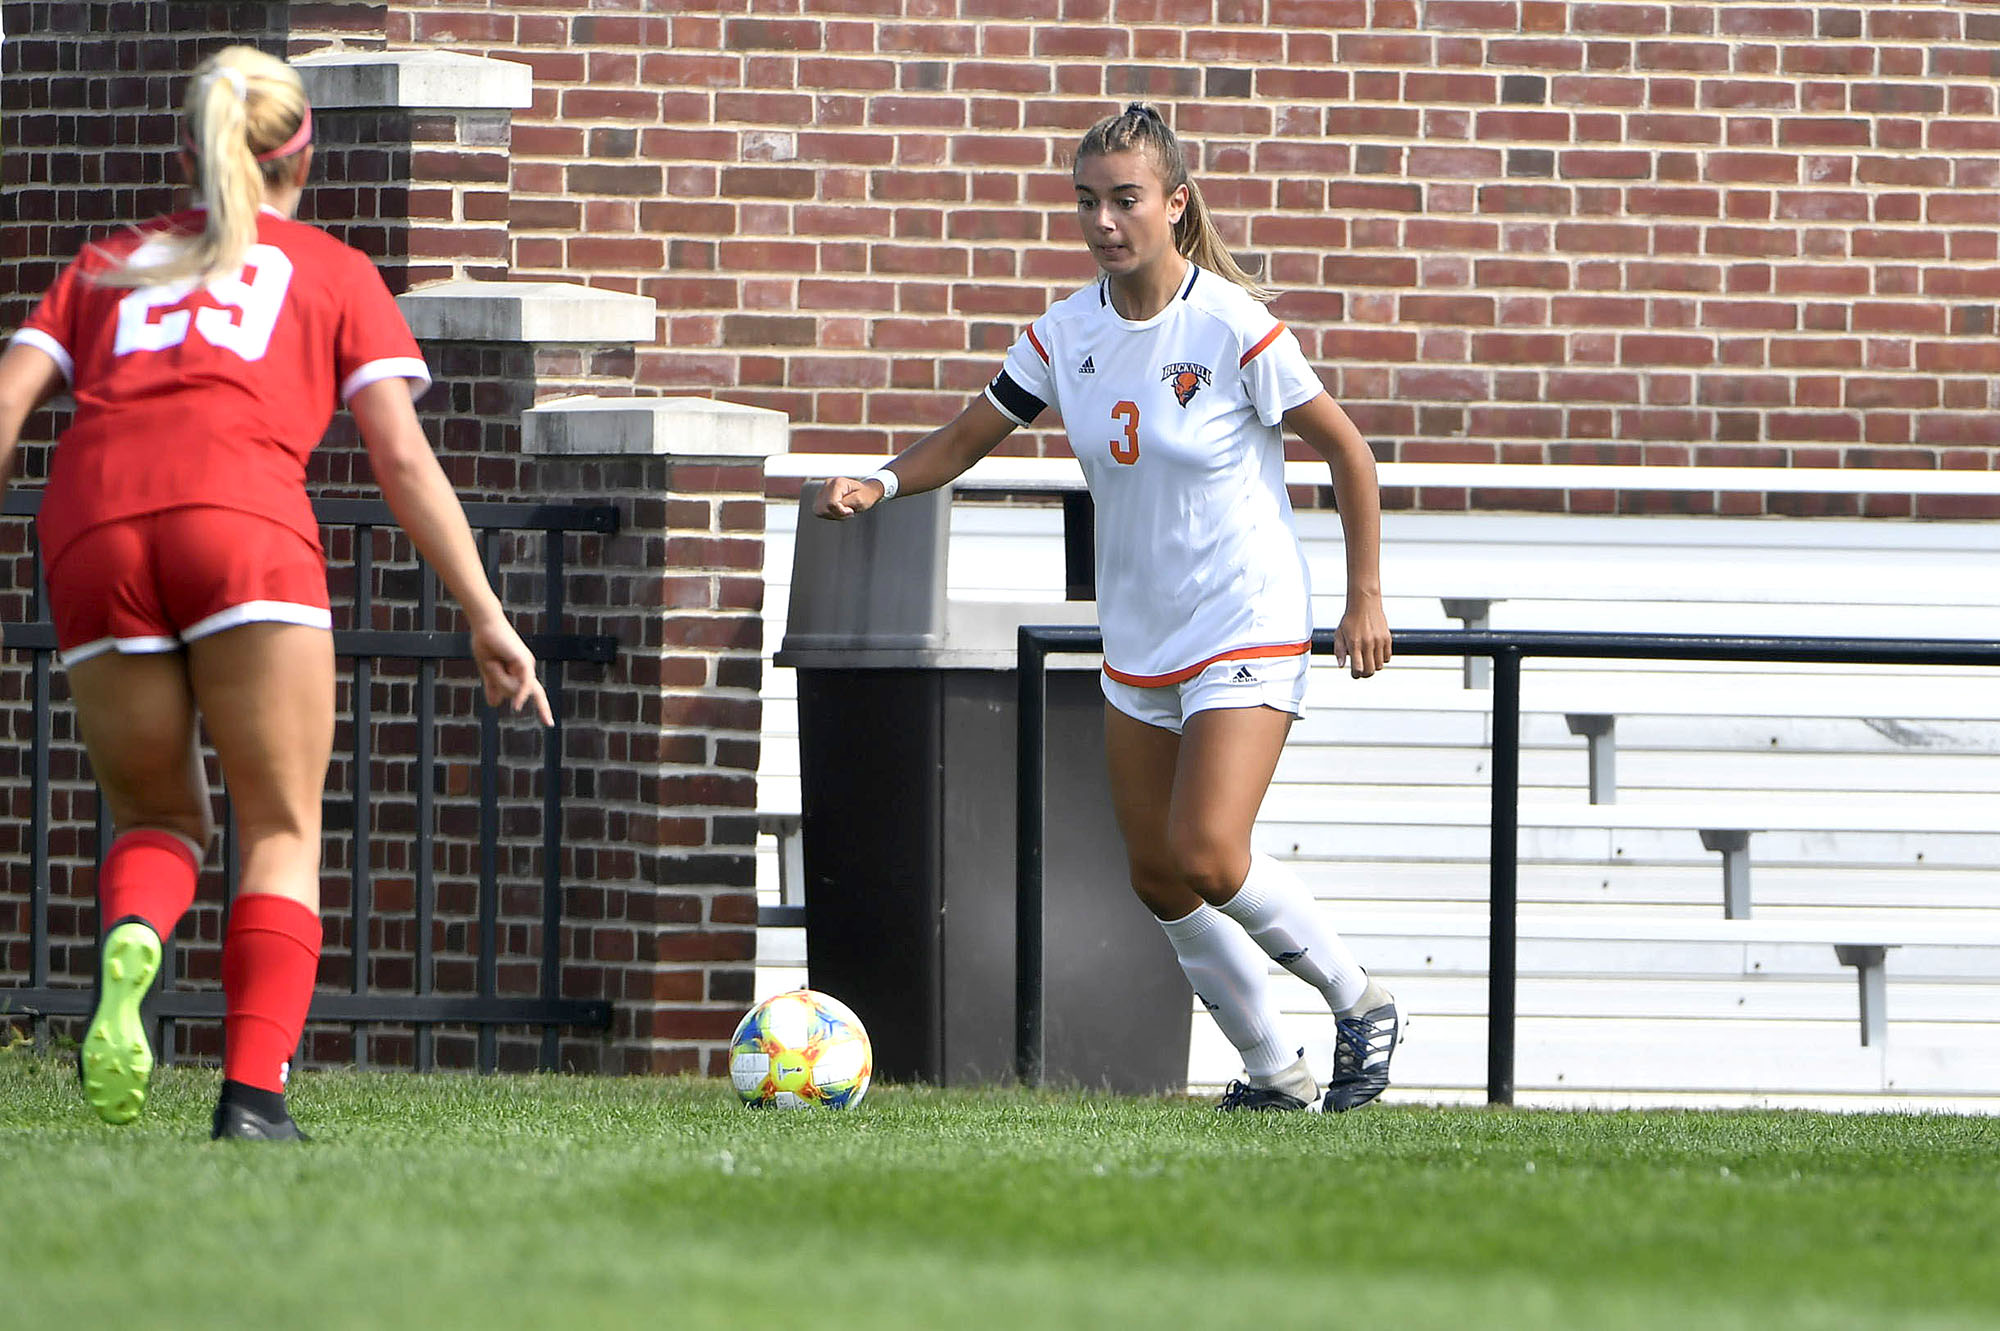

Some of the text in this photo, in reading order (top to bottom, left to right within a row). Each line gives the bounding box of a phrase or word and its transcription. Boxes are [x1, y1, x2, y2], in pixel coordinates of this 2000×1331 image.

[113, 243, 294, 362] 29
[1161, 362, 1212, 386] BUCKNELL
[1109, 400, 1140, 465] 3
